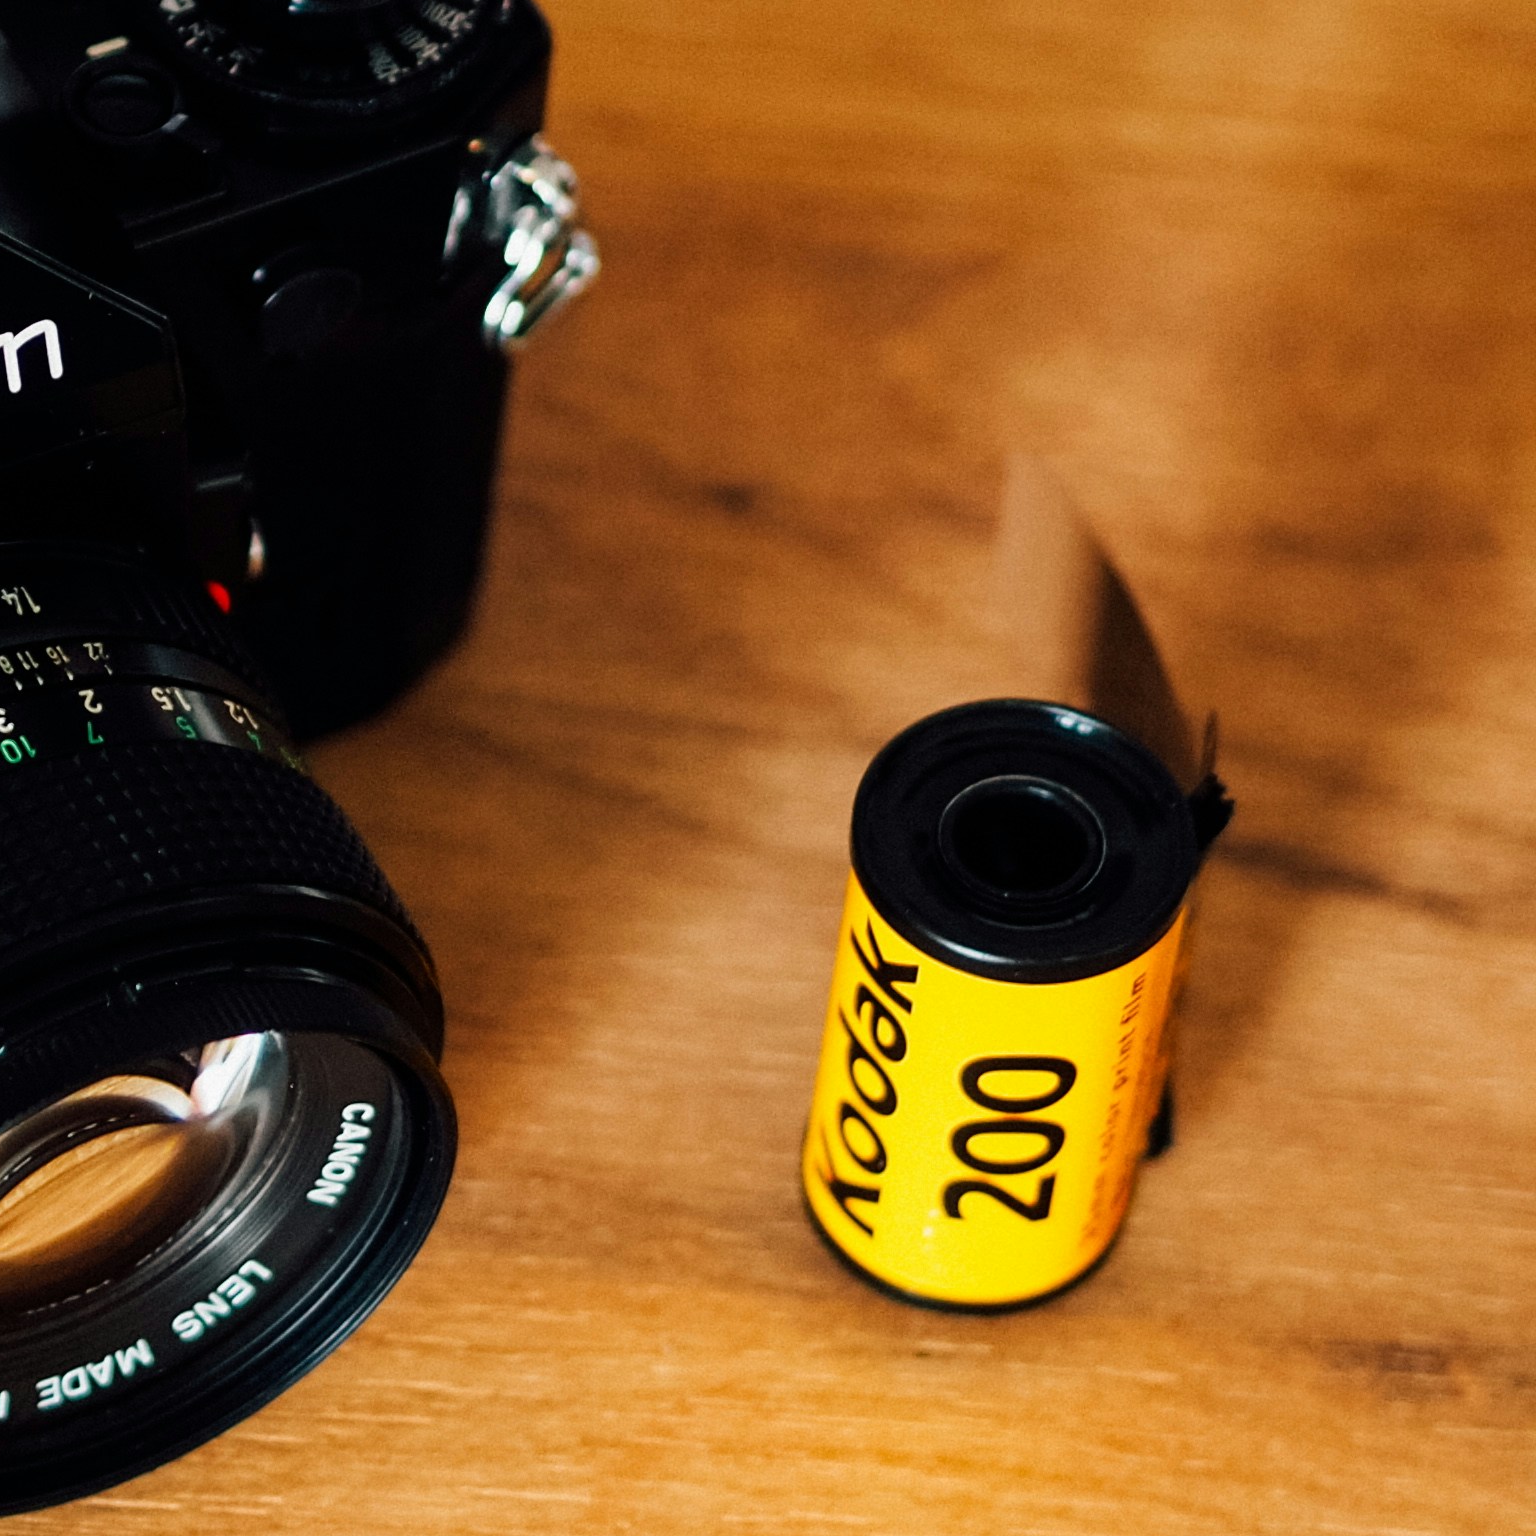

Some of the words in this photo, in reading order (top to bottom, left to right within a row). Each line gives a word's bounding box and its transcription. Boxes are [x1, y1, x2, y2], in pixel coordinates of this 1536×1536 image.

[78, 689, 103, 714] 2
[0, 735, 36, 763] 10
[1120, 972, 1147, 1026] film
[816, 916, 920, 1238] Kodak
[1113, 1027, 1136, 1092] print
[306, 1102, 375, 1207] CANON
[940, 1056, 1079, 1223] 200
[171, 1260, 272, 1341] LENS
[35, 1338, 155, 1409] MADE
